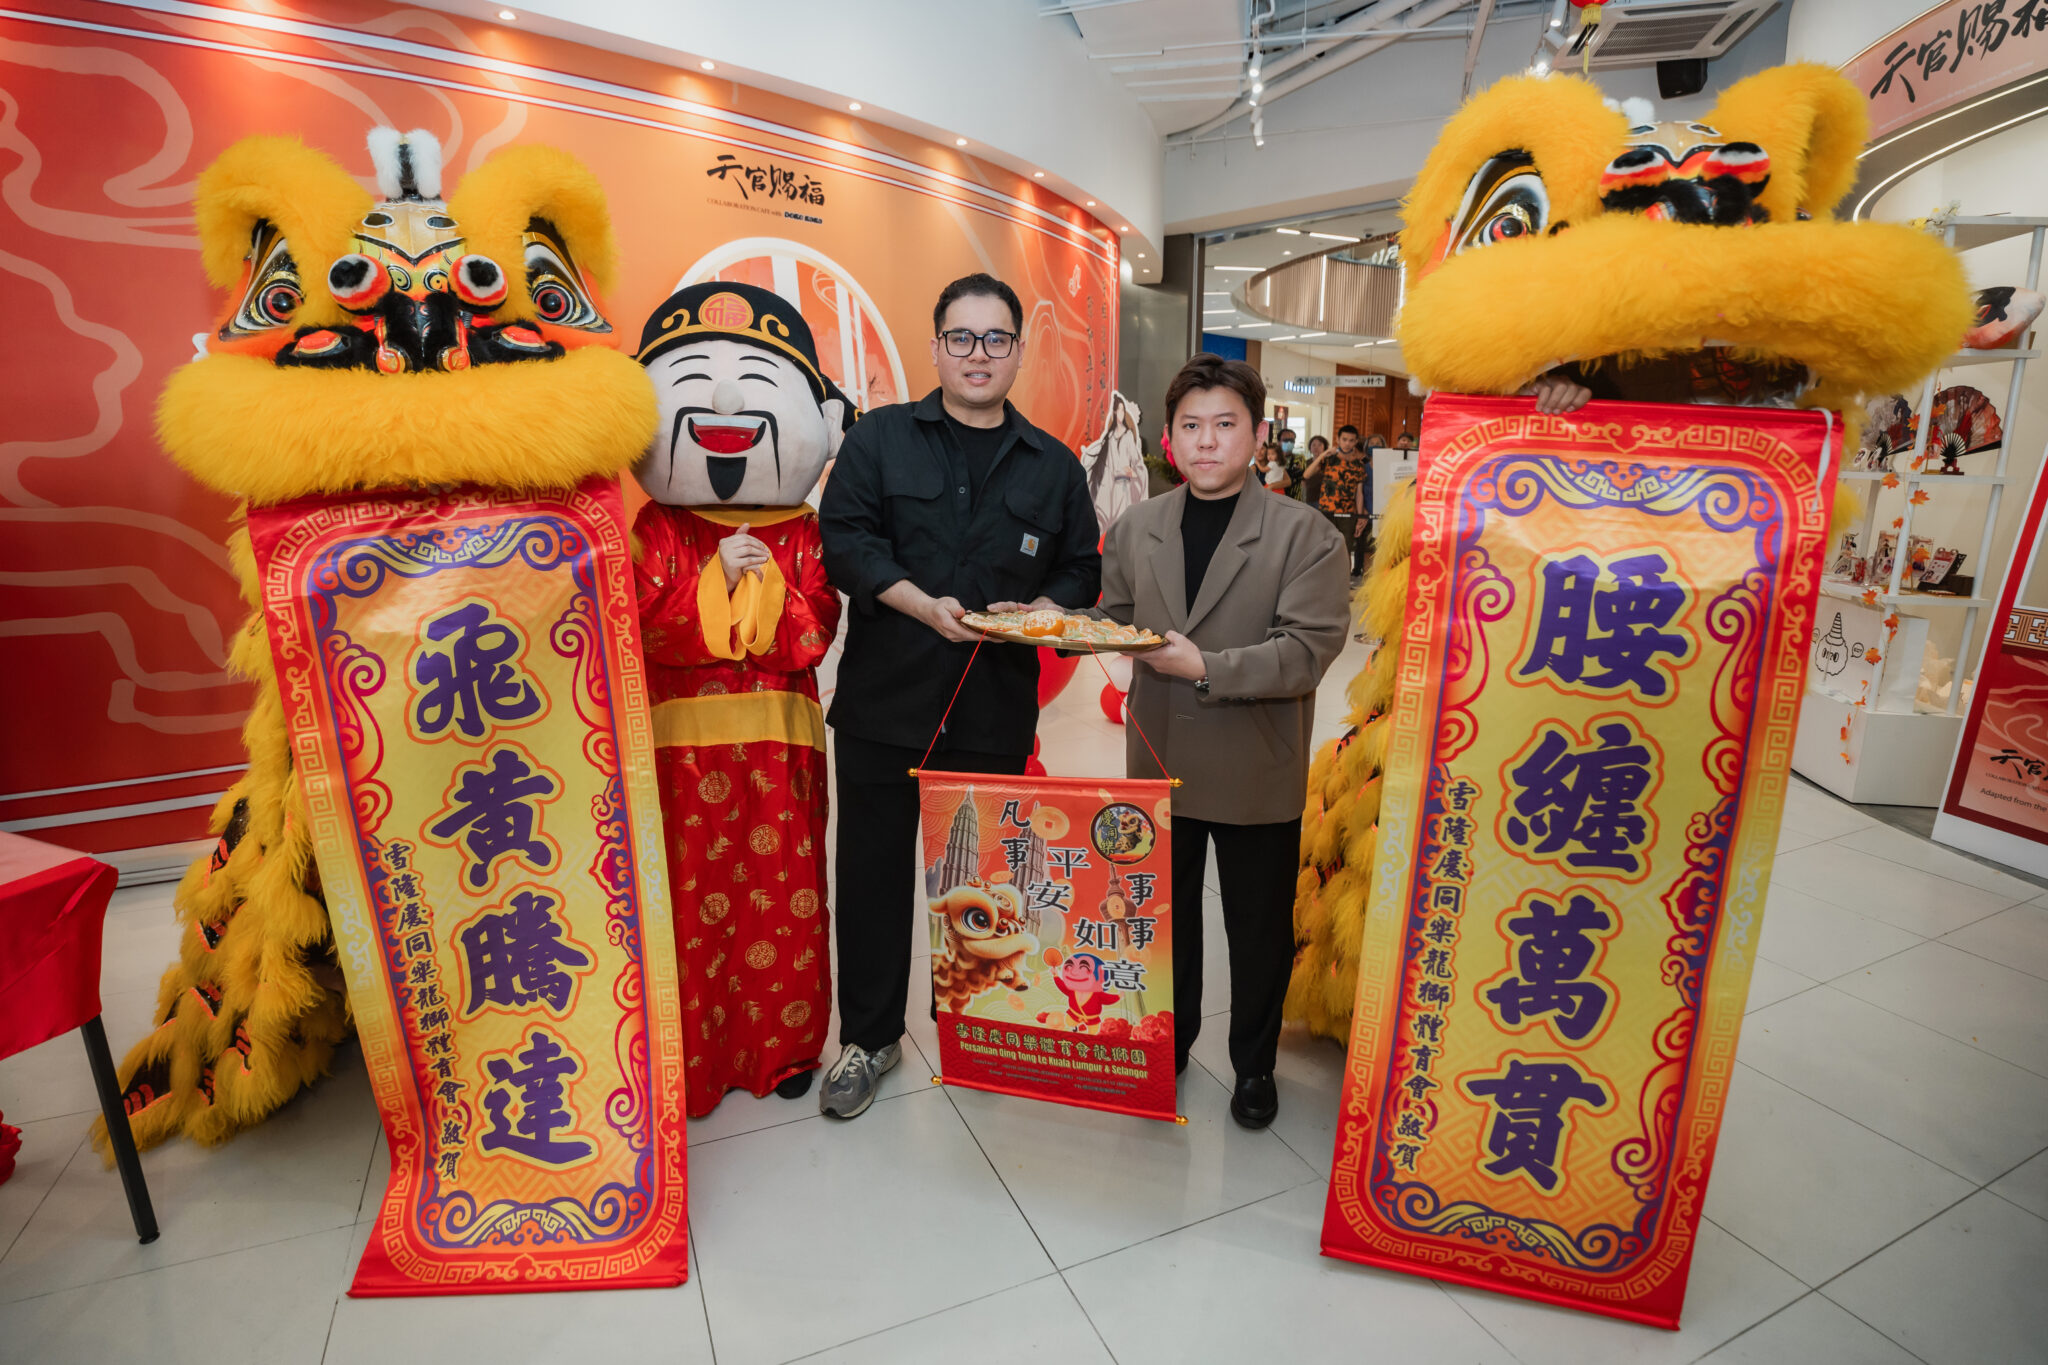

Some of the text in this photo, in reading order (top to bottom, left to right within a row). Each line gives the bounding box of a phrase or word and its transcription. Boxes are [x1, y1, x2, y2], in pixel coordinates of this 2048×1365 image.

[1981, 788, 2048, 812] Adapted from the
[1466, 553, 1688, 1190] 腰纏萬貫
[960, 1041, 998, 1056] Persatuan
[999, 1047, 1017, 1061] Qing
[1018, 1051, 1037, 1064] Tong
[1038, 1053, 1047, 1064] Le
[1048, 1056, 1071, 1068] Kuala
[1072, 1058, 1102, 1073] Lumpur
[1104, 1064, 1111, 1074] &
[1112, 1065, 1149, 1080] Selangor
